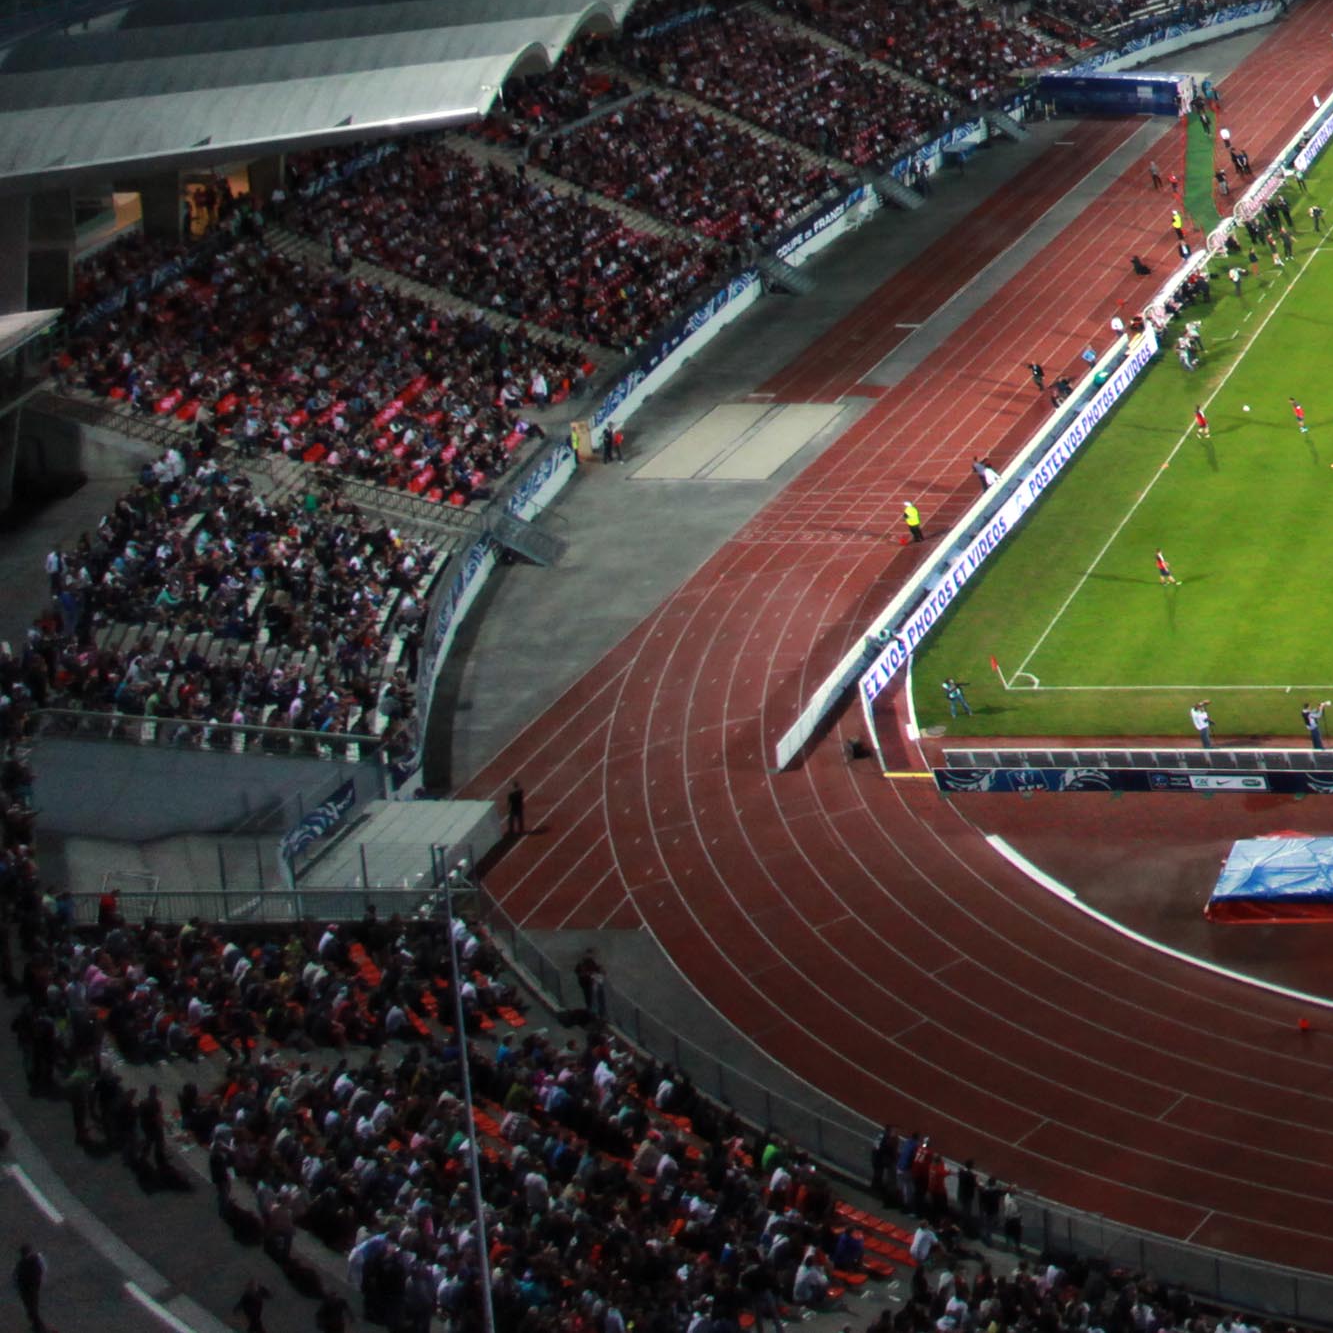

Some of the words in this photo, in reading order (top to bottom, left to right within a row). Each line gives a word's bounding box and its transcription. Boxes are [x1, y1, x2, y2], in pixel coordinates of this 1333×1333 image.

[1028, 447, 1069, 497] POSTEZ
[1065, 426, 1083, 455] VOS
[1082, 389, 1114, 435] PHOTOS
[1113, 374, 1126, 397] ET
[1124, 344, 1150, 381] VIDEOS
[881, 640, 907, 671] VOS
[907, 583, 953, 647] PHOTOS
[953, 564, 969, 588] ET
[968, 516, 1007, 568] VIDEOS
